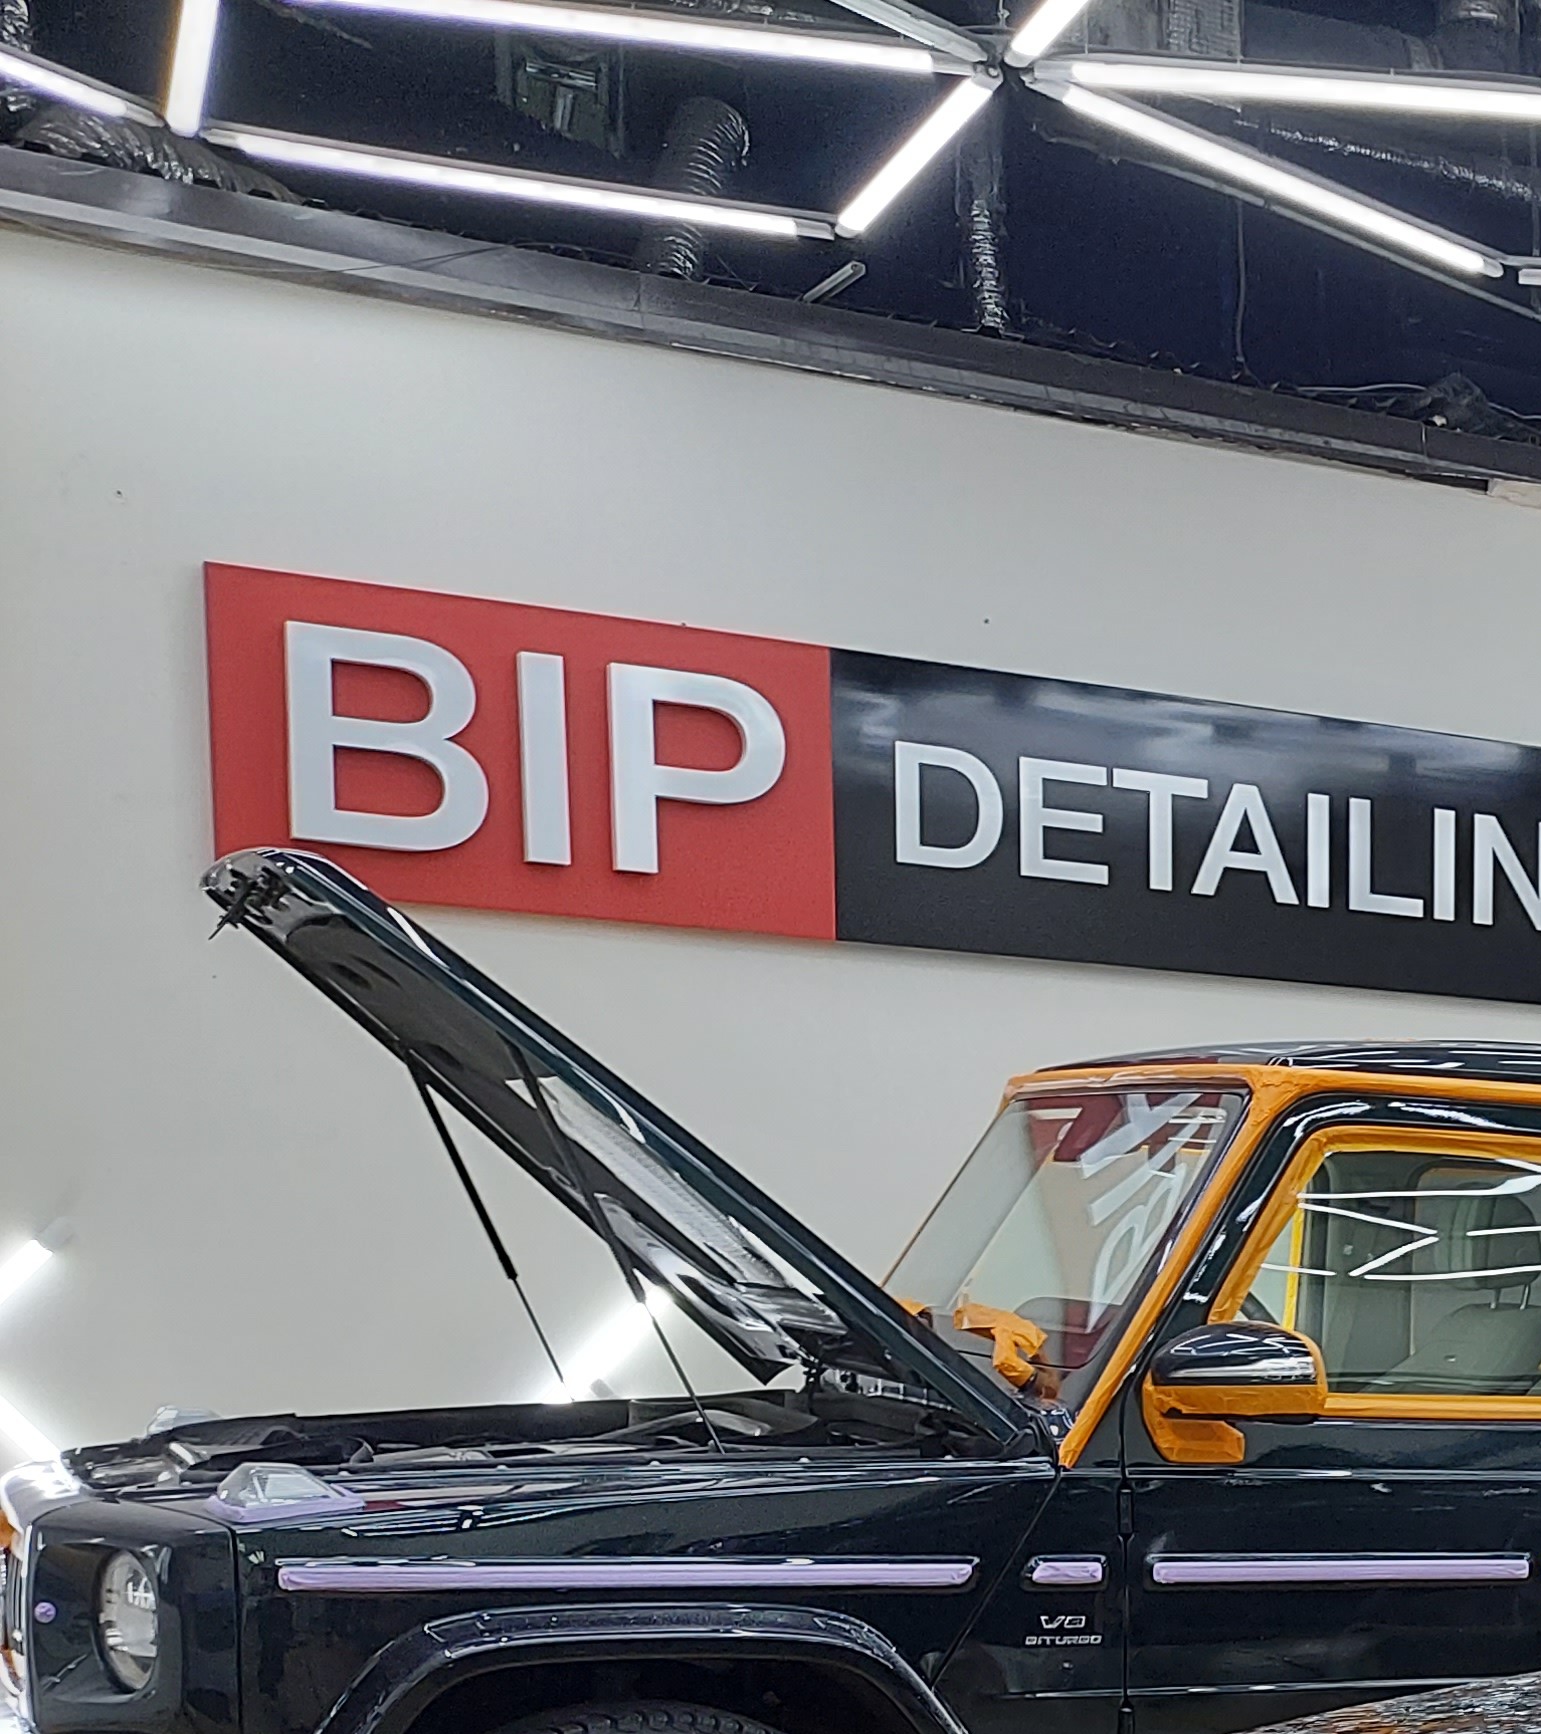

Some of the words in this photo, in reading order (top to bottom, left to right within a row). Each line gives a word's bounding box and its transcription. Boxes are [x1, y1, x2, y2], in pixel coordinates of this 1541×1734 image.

[284, 620, 787, 874] BIP
[1040, 1616, 1086, 1629] V8
[1025, 1635, 1102, 1645] BITURBO
